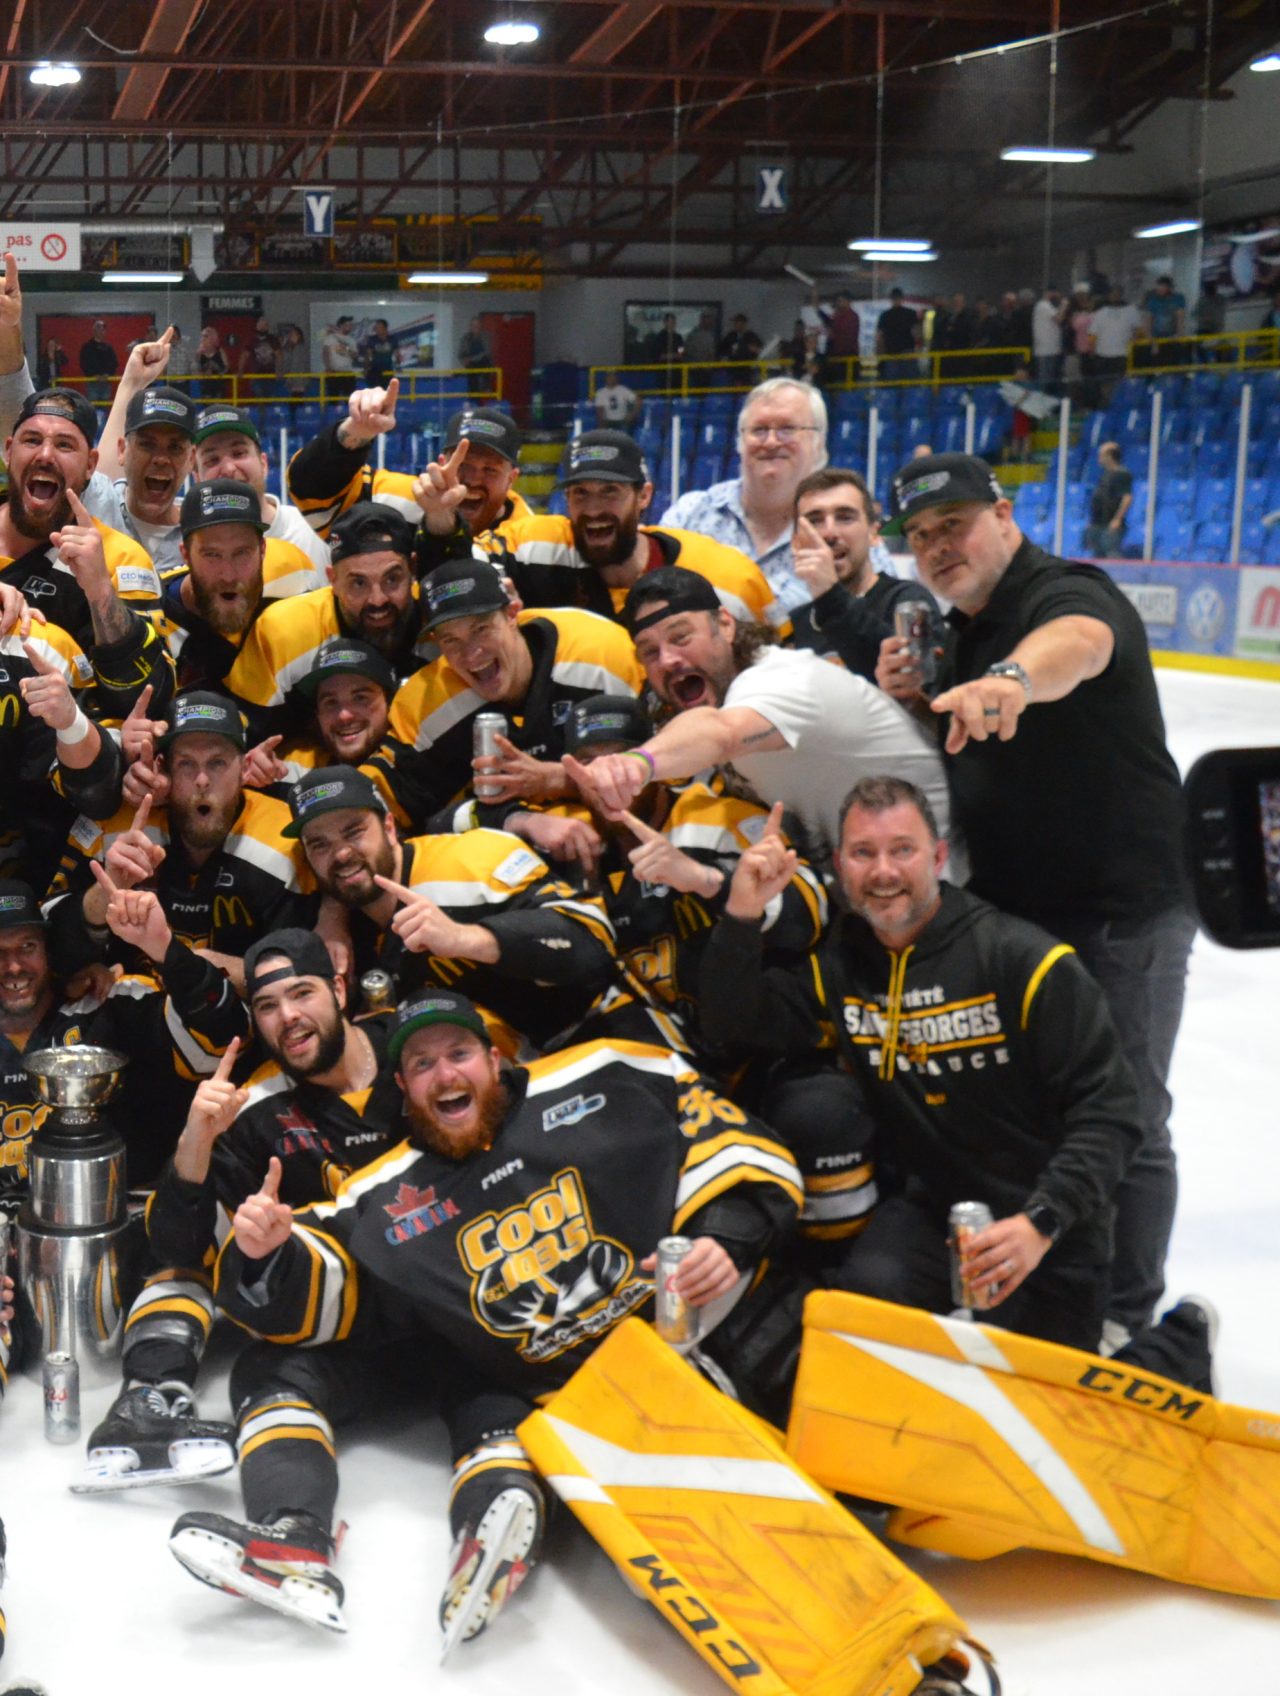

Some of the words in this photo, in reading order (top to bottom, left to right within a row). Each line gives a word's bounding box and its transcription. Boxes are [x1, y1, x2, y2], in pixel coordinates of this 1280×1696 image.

[760, 169, 784, 208] X
[306, 196, 330, 233] Y
[6, 235, 33, 248] pas
[209, 297, 255, 309] FEMMES
[481, 1159, 524, 1191] MNM
[384, 1198, 462, 1246] CANADIAN
[463, 1173, 582, 1273] Cool
[501, 1216, 590, 1292] 103.5
[1077, 1363, 1203, 1421] CCM
[629, 1553, 762, 1681] CCM
